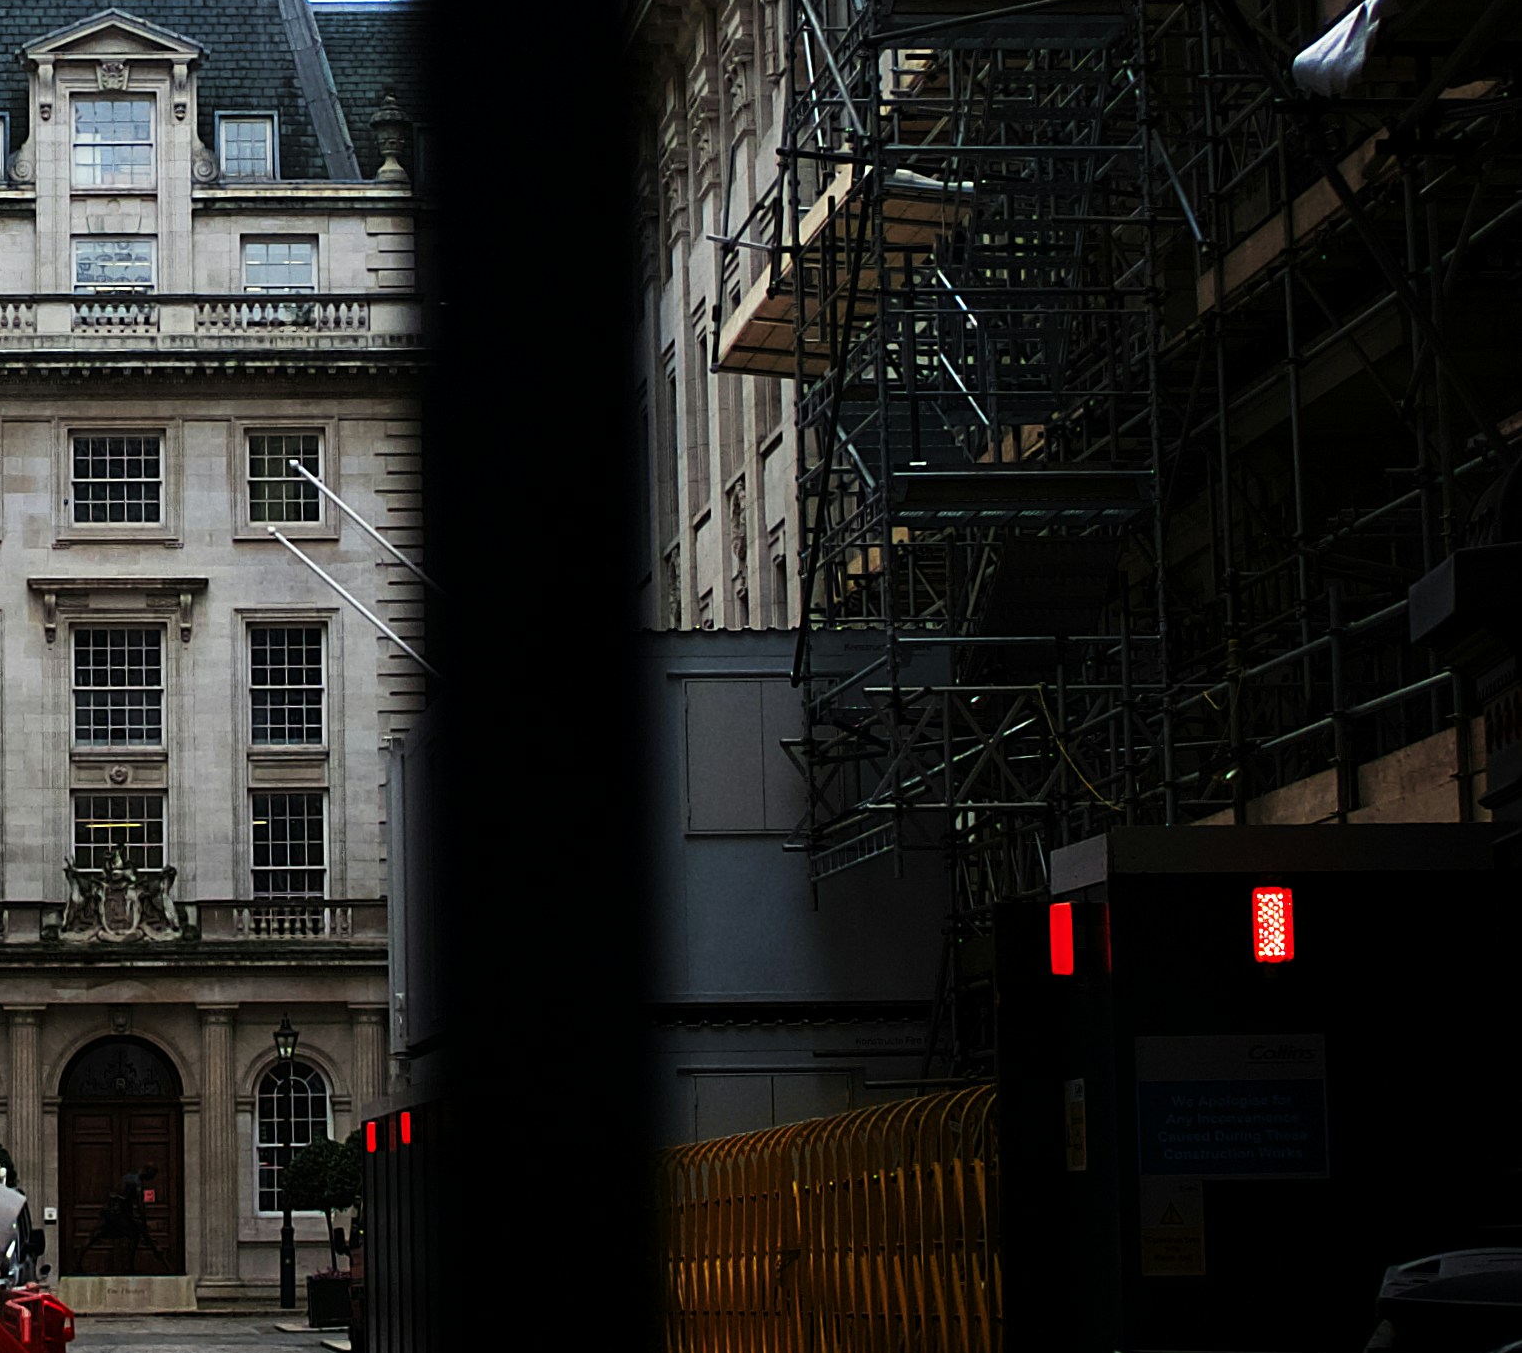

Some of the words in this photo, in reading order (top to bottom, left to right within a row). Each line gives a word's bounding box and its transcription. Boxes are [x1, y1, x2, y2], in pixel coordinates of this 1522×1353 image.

[1248, 1044, 1317, 1061] Collins
[1170, 1094, 1194, 1107] We
[1272, 1094, 1292, 1106] for
[1165, 1113, 1195, 1128] Any
[1197, 1112, 1300, 1125] Inconvenience
[1157, 1130, 1211, 1143] Caused
[1214, 1130, 1262, 1144] During
[1264, 1129, 1308, 1142] These
[1163, 1147, 1255, 1160] Construction
[1258, 1146, 1303, 1159] Works
